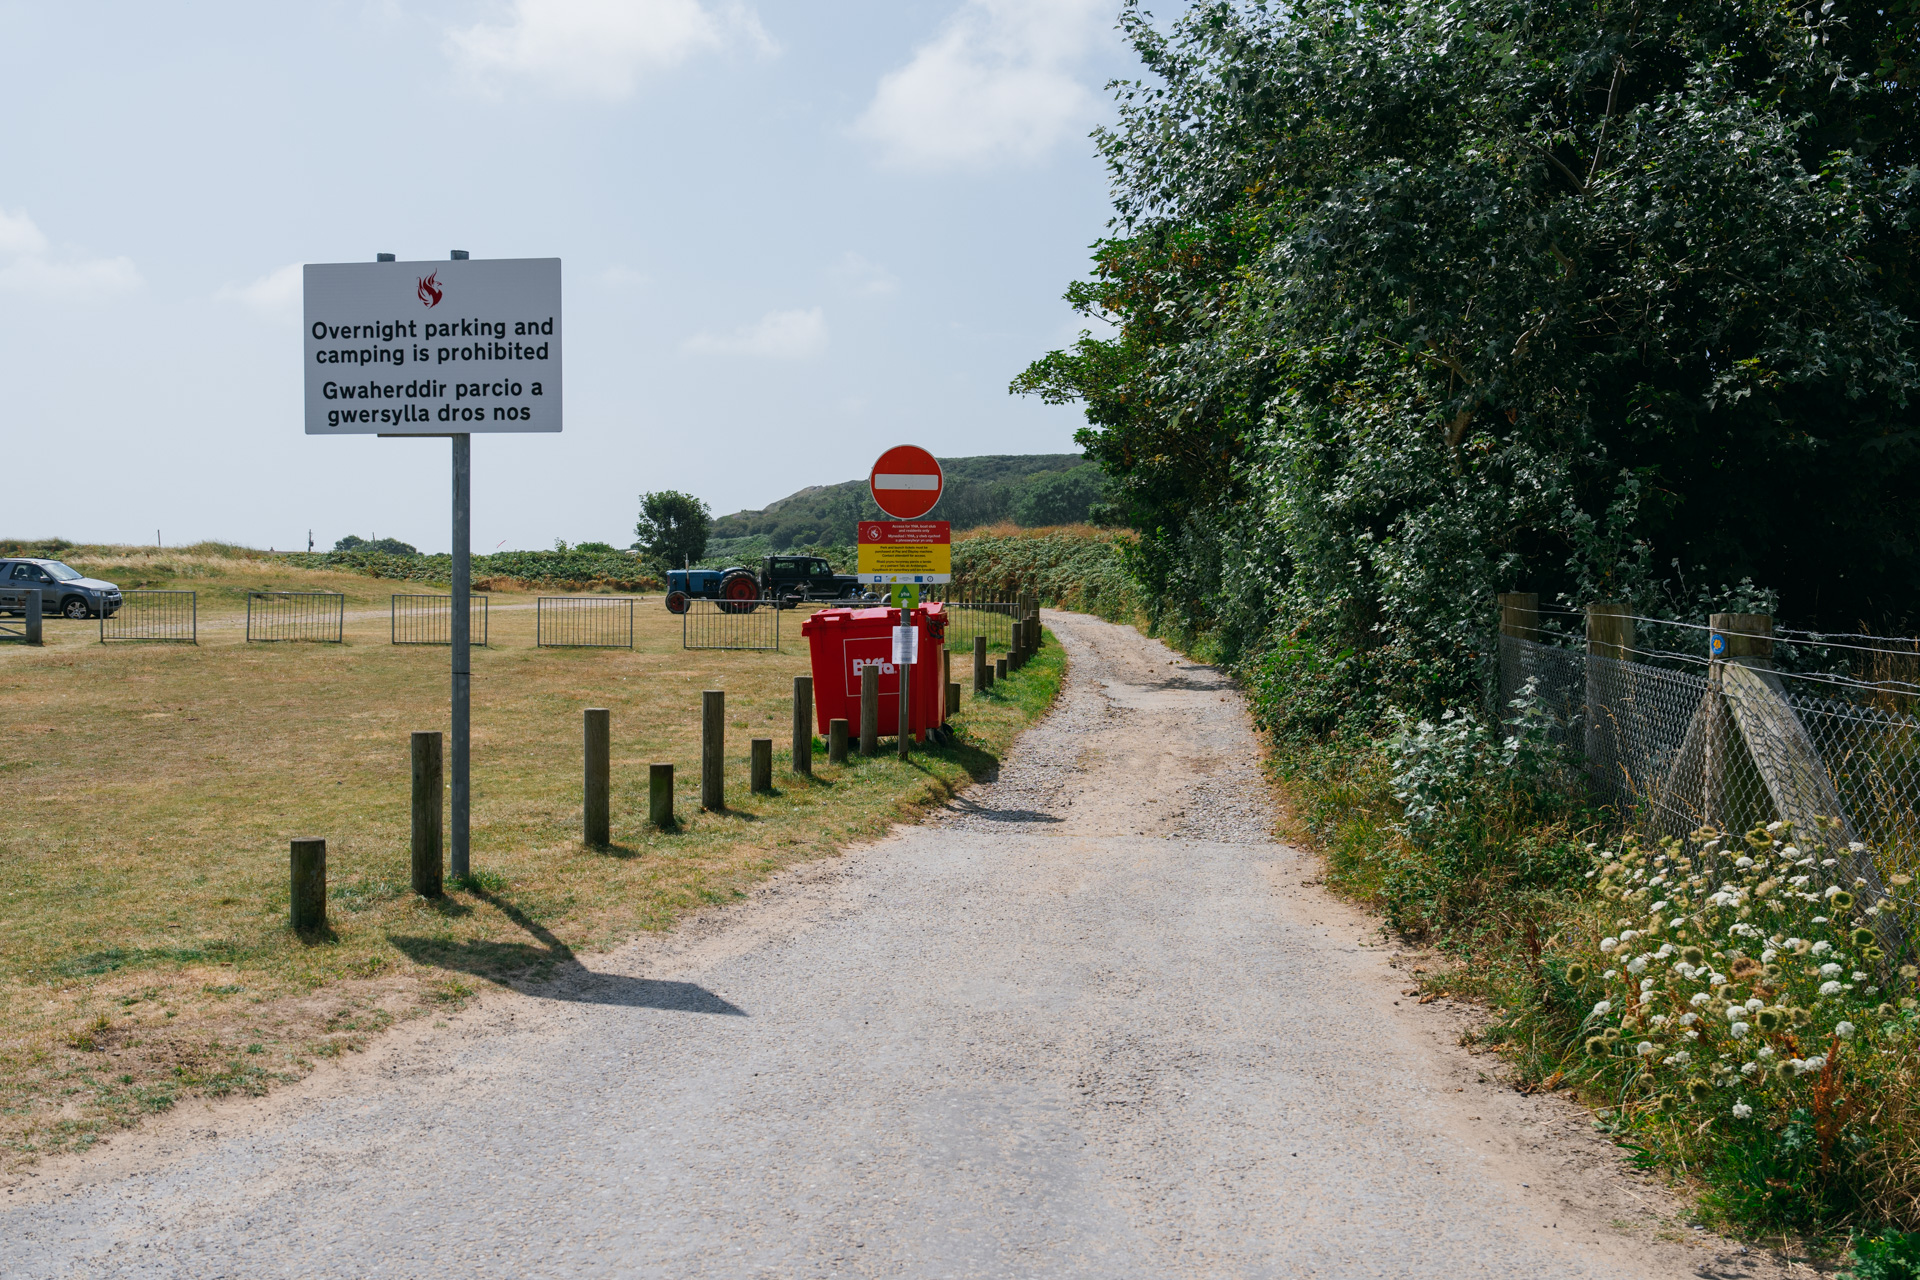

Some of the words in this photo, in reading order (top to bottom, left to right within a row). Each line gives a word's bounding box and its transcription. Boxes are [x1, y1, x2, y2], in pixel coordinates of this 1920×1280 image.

[312, 319, 417, 341] Overnight
[425, 318, 506, 340] parking
[514, 317, 553, 335] and
[316, 345, 404, 366] camping
[413, 344, 430, 362] is
[438, 342, 549, 364] prohibited
[323, 380, 447, 400] Gwaherddir
[455, 378, 522, 400] parcio
[531, 382, 543, 396] a
[328, 404, 430, 427] gwersylla
[438, 404, 485, 421] dros
[493, 406, 531, 420] nos
